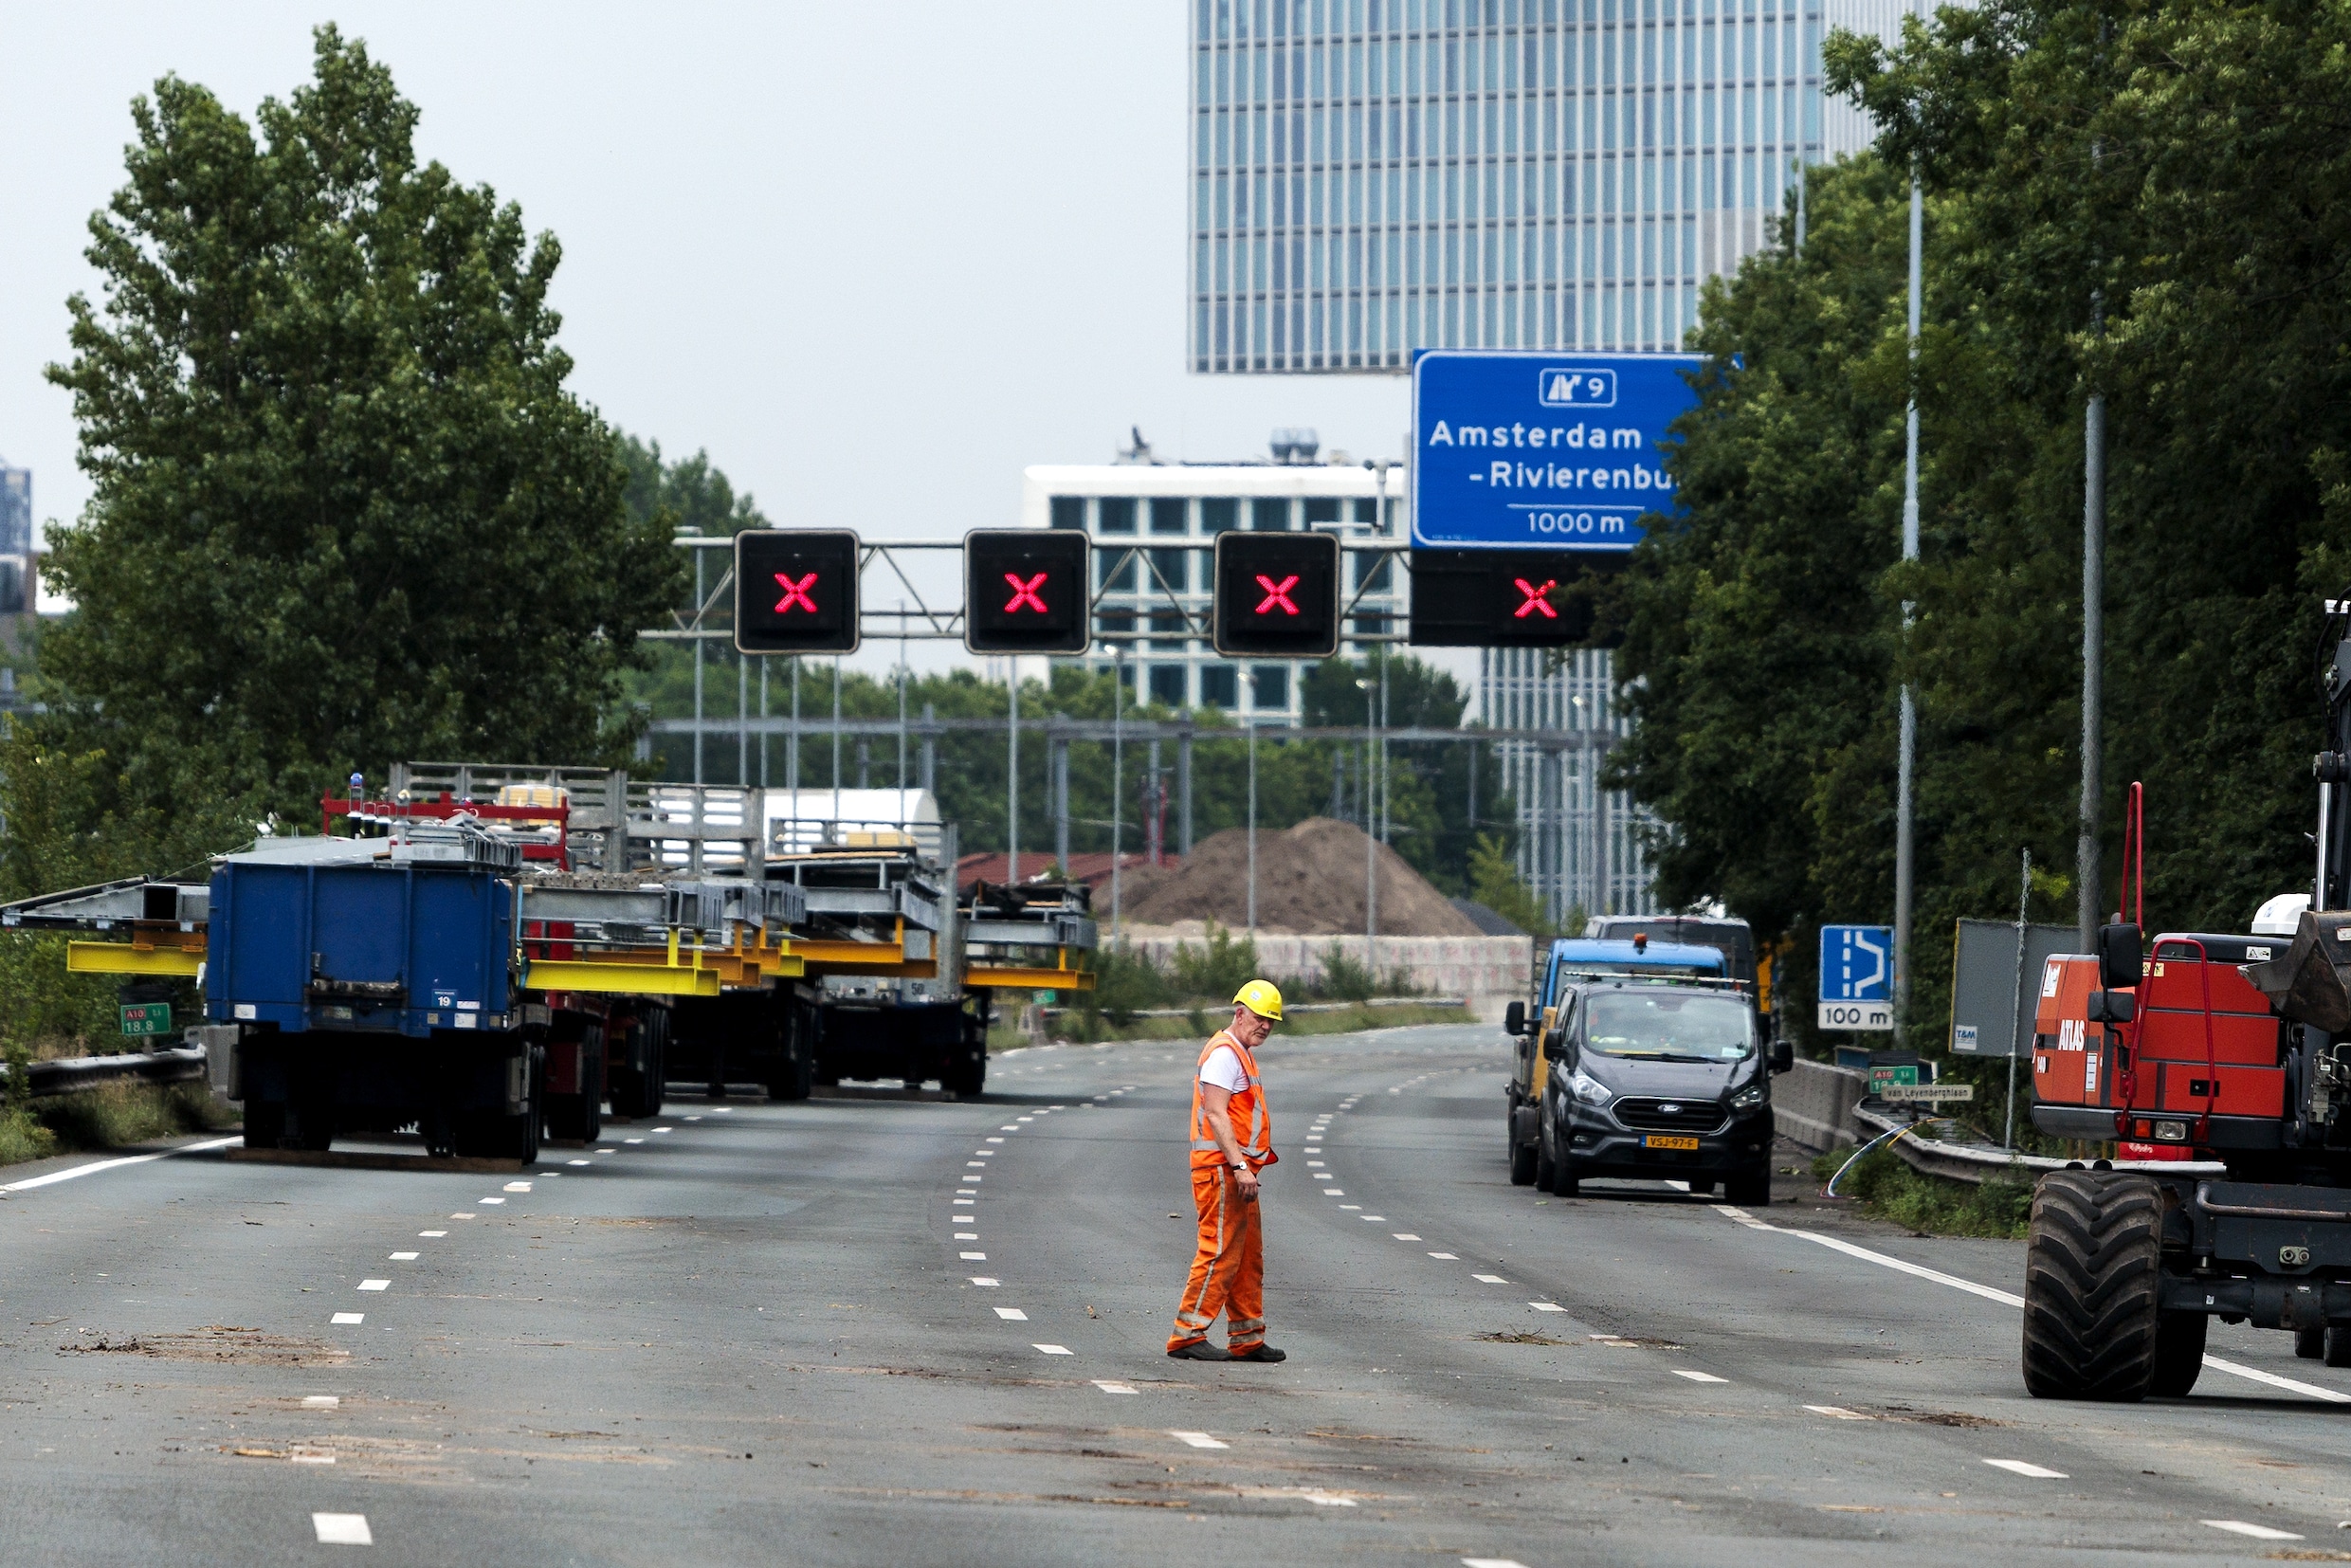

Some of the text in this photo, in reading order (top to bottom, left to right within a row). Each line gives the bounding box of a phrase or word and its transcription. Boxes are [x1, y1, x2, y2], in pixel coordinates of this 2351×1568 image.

[1588, 377, 1605, 398] 9
[1429, 420, 1642, 448] Amsterdam
[1468, 461, 1681, 490] -Rivierenbu
[1527, 512, 1625, 534] 1000 m
[437, 995, 451, 1007] 19
[126, 1010, 145, 1018] A10
[1826, 1007, 1888, 1025] 100 m
[126, 1020, 154, 1032] 18.8
[1956, 1030, 1976, 1039] T&M
[2057, 1019, 2086, 1052] ATLAS
[1874, 1070, 1893, 1079] A10
